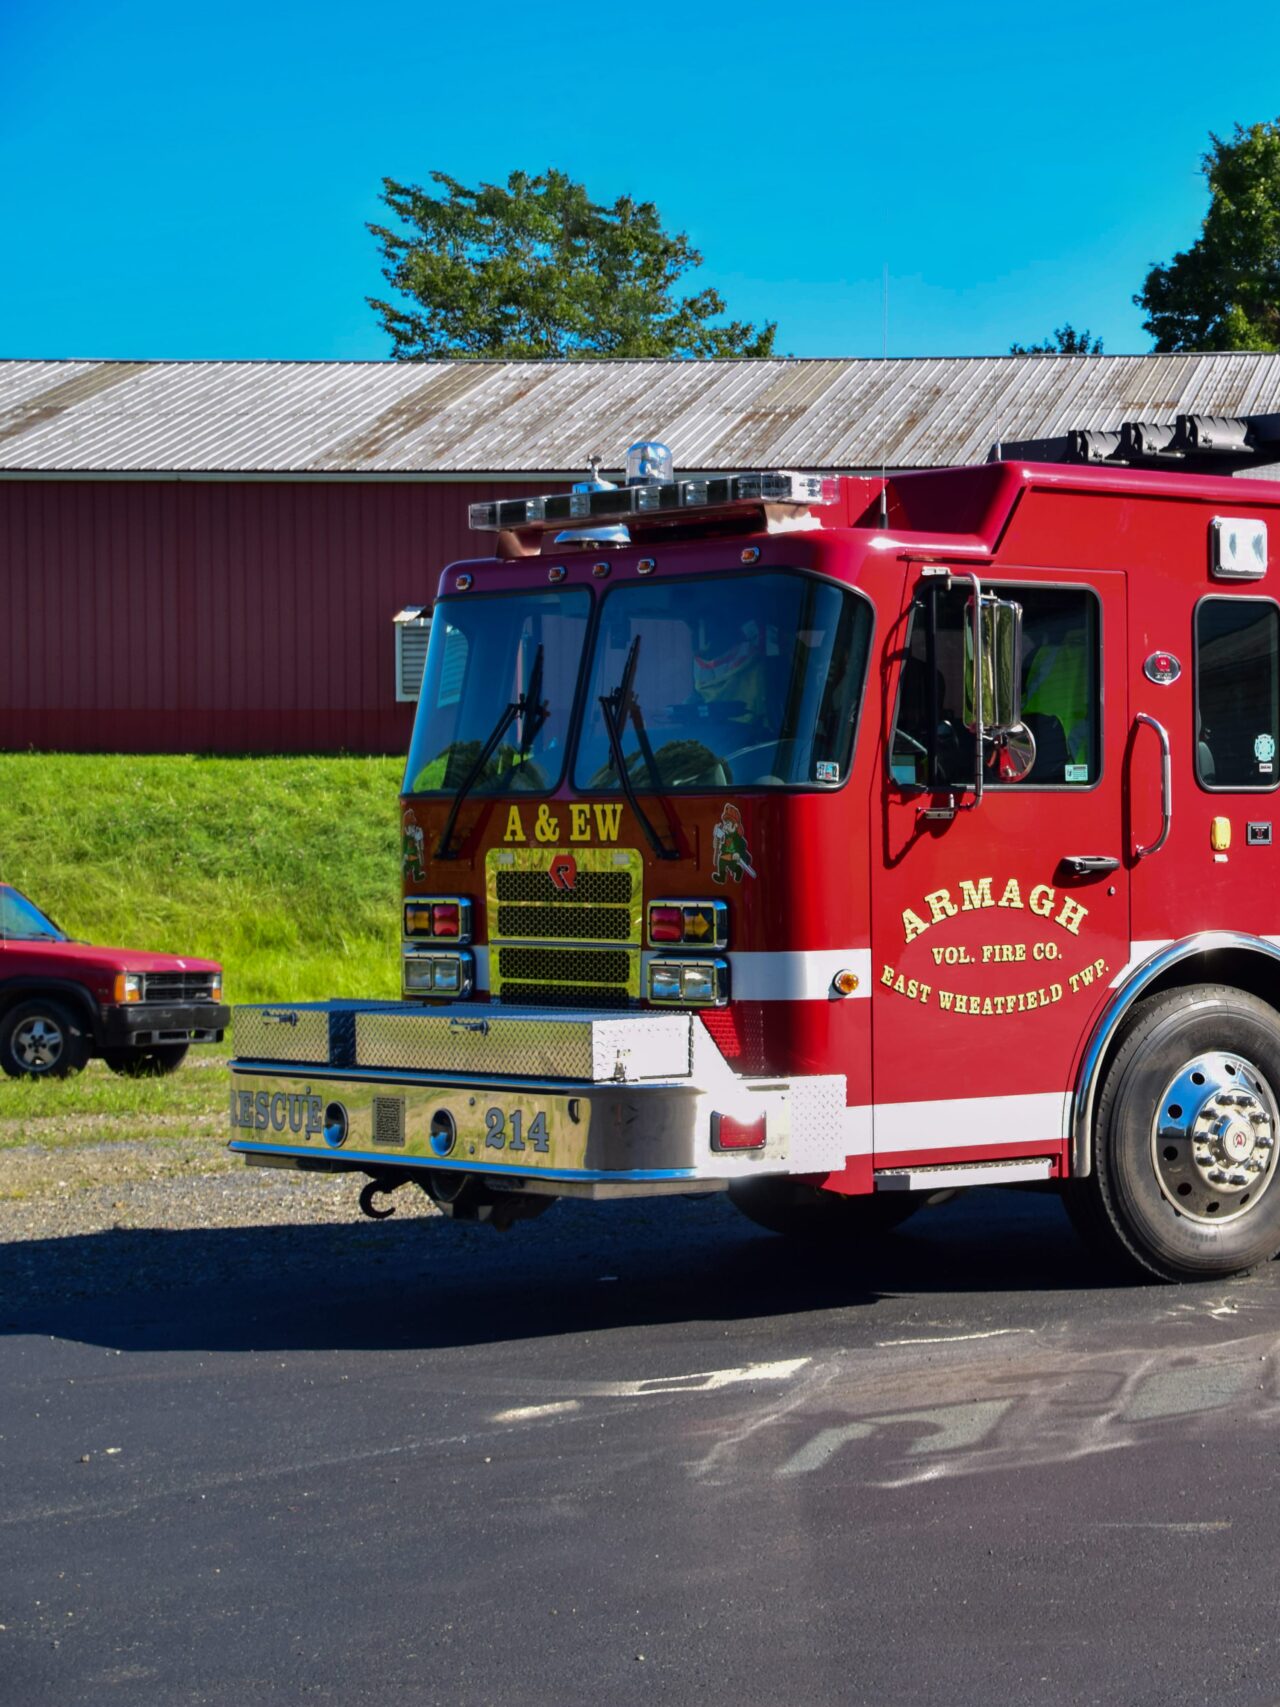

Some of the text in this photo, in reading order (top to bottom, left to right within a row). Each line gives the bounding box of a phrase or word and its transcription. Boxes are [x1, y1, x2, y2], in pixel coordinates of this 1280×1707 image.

[503, 803, 624, 842] A & EW
[901, 877, 1089, 943] ARMAGH
[932, 942, 1063, 965] VOL. FIRE CO.
[880, 958, 1110, 1015] EAST WHEATFIELD TWP.
[485, 1106, 550, 1153] 214
